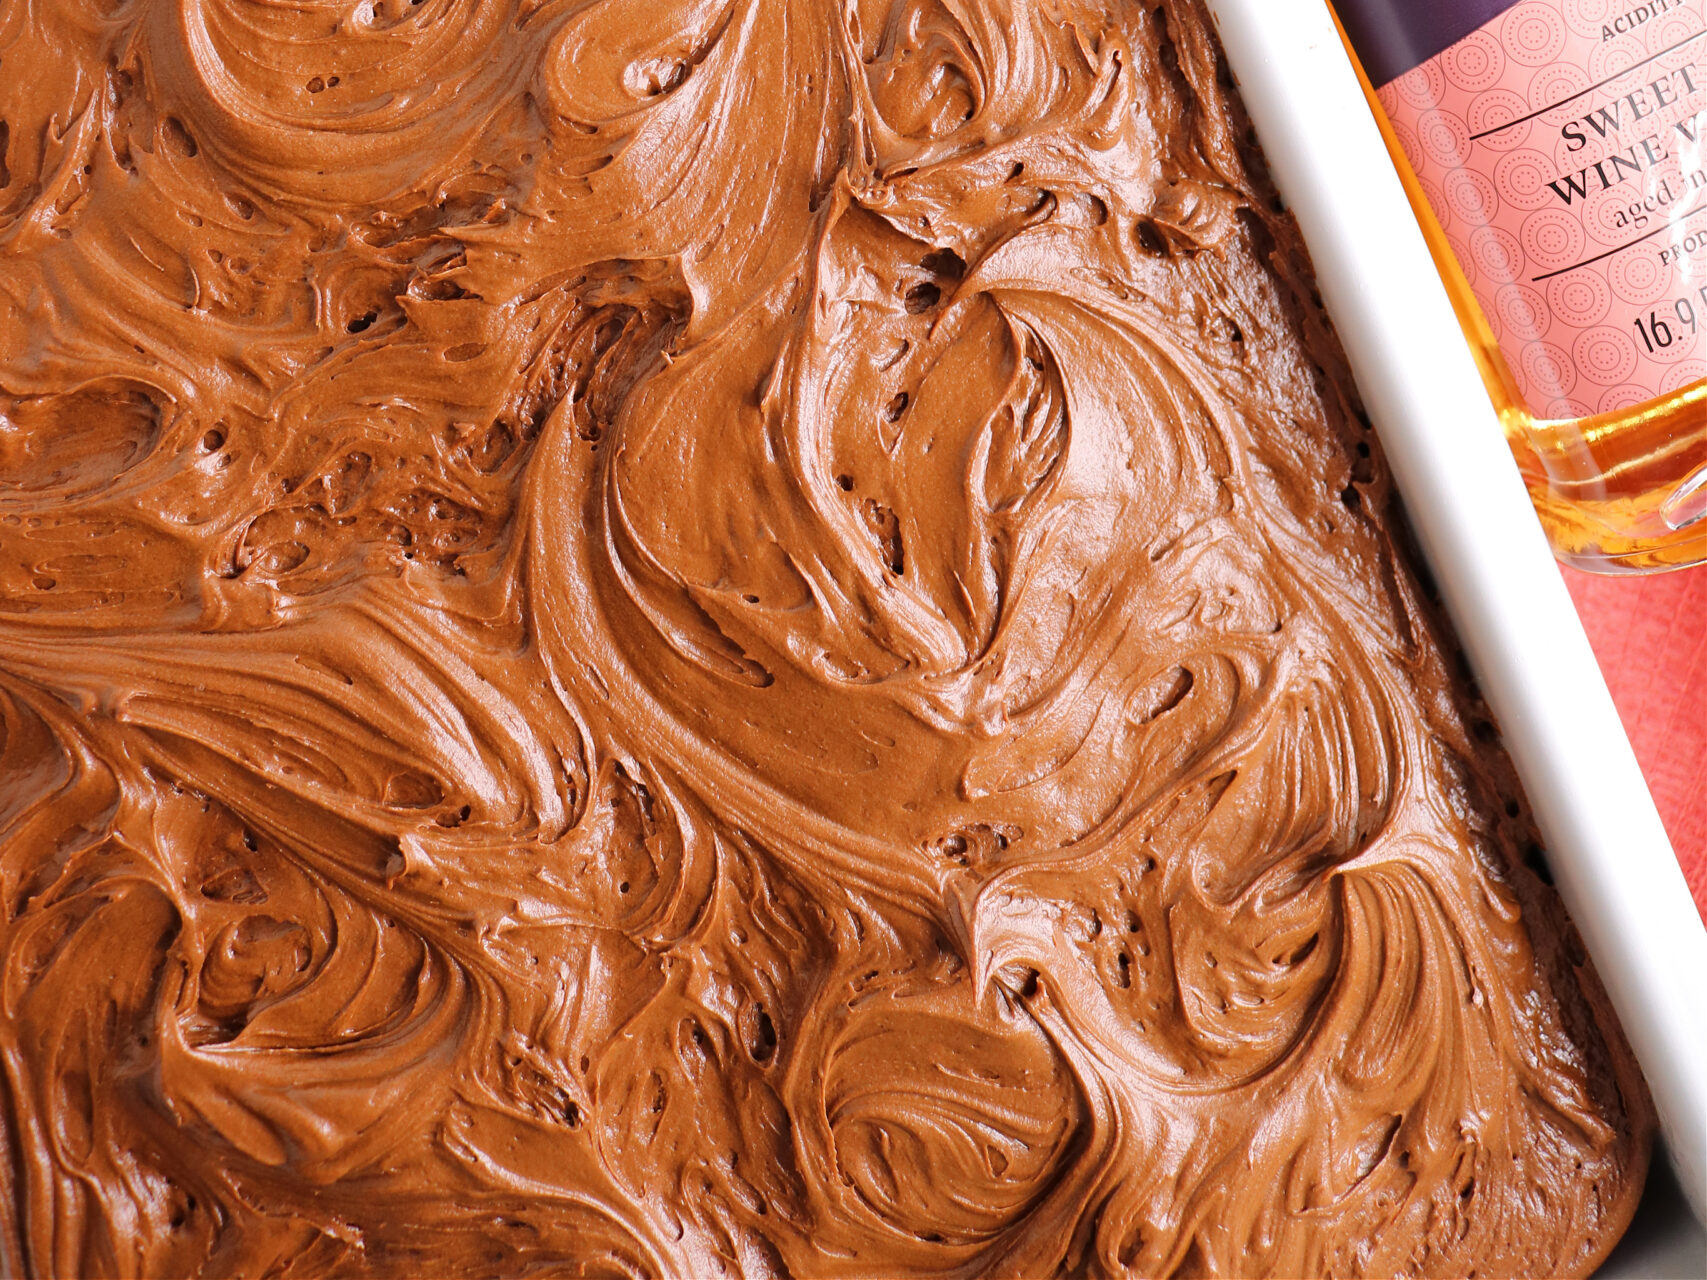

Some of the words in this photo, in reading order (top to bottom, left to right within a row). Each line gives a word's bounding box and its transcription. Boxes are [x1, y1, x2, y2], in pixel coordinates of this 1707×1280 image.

[1561, 62, 1697, 152] SWEET
[1545, 133, 1669, 206] WINE
[1613, 179, 1676, 230] aged
[1633, 297, 1696, 353] 16.9
